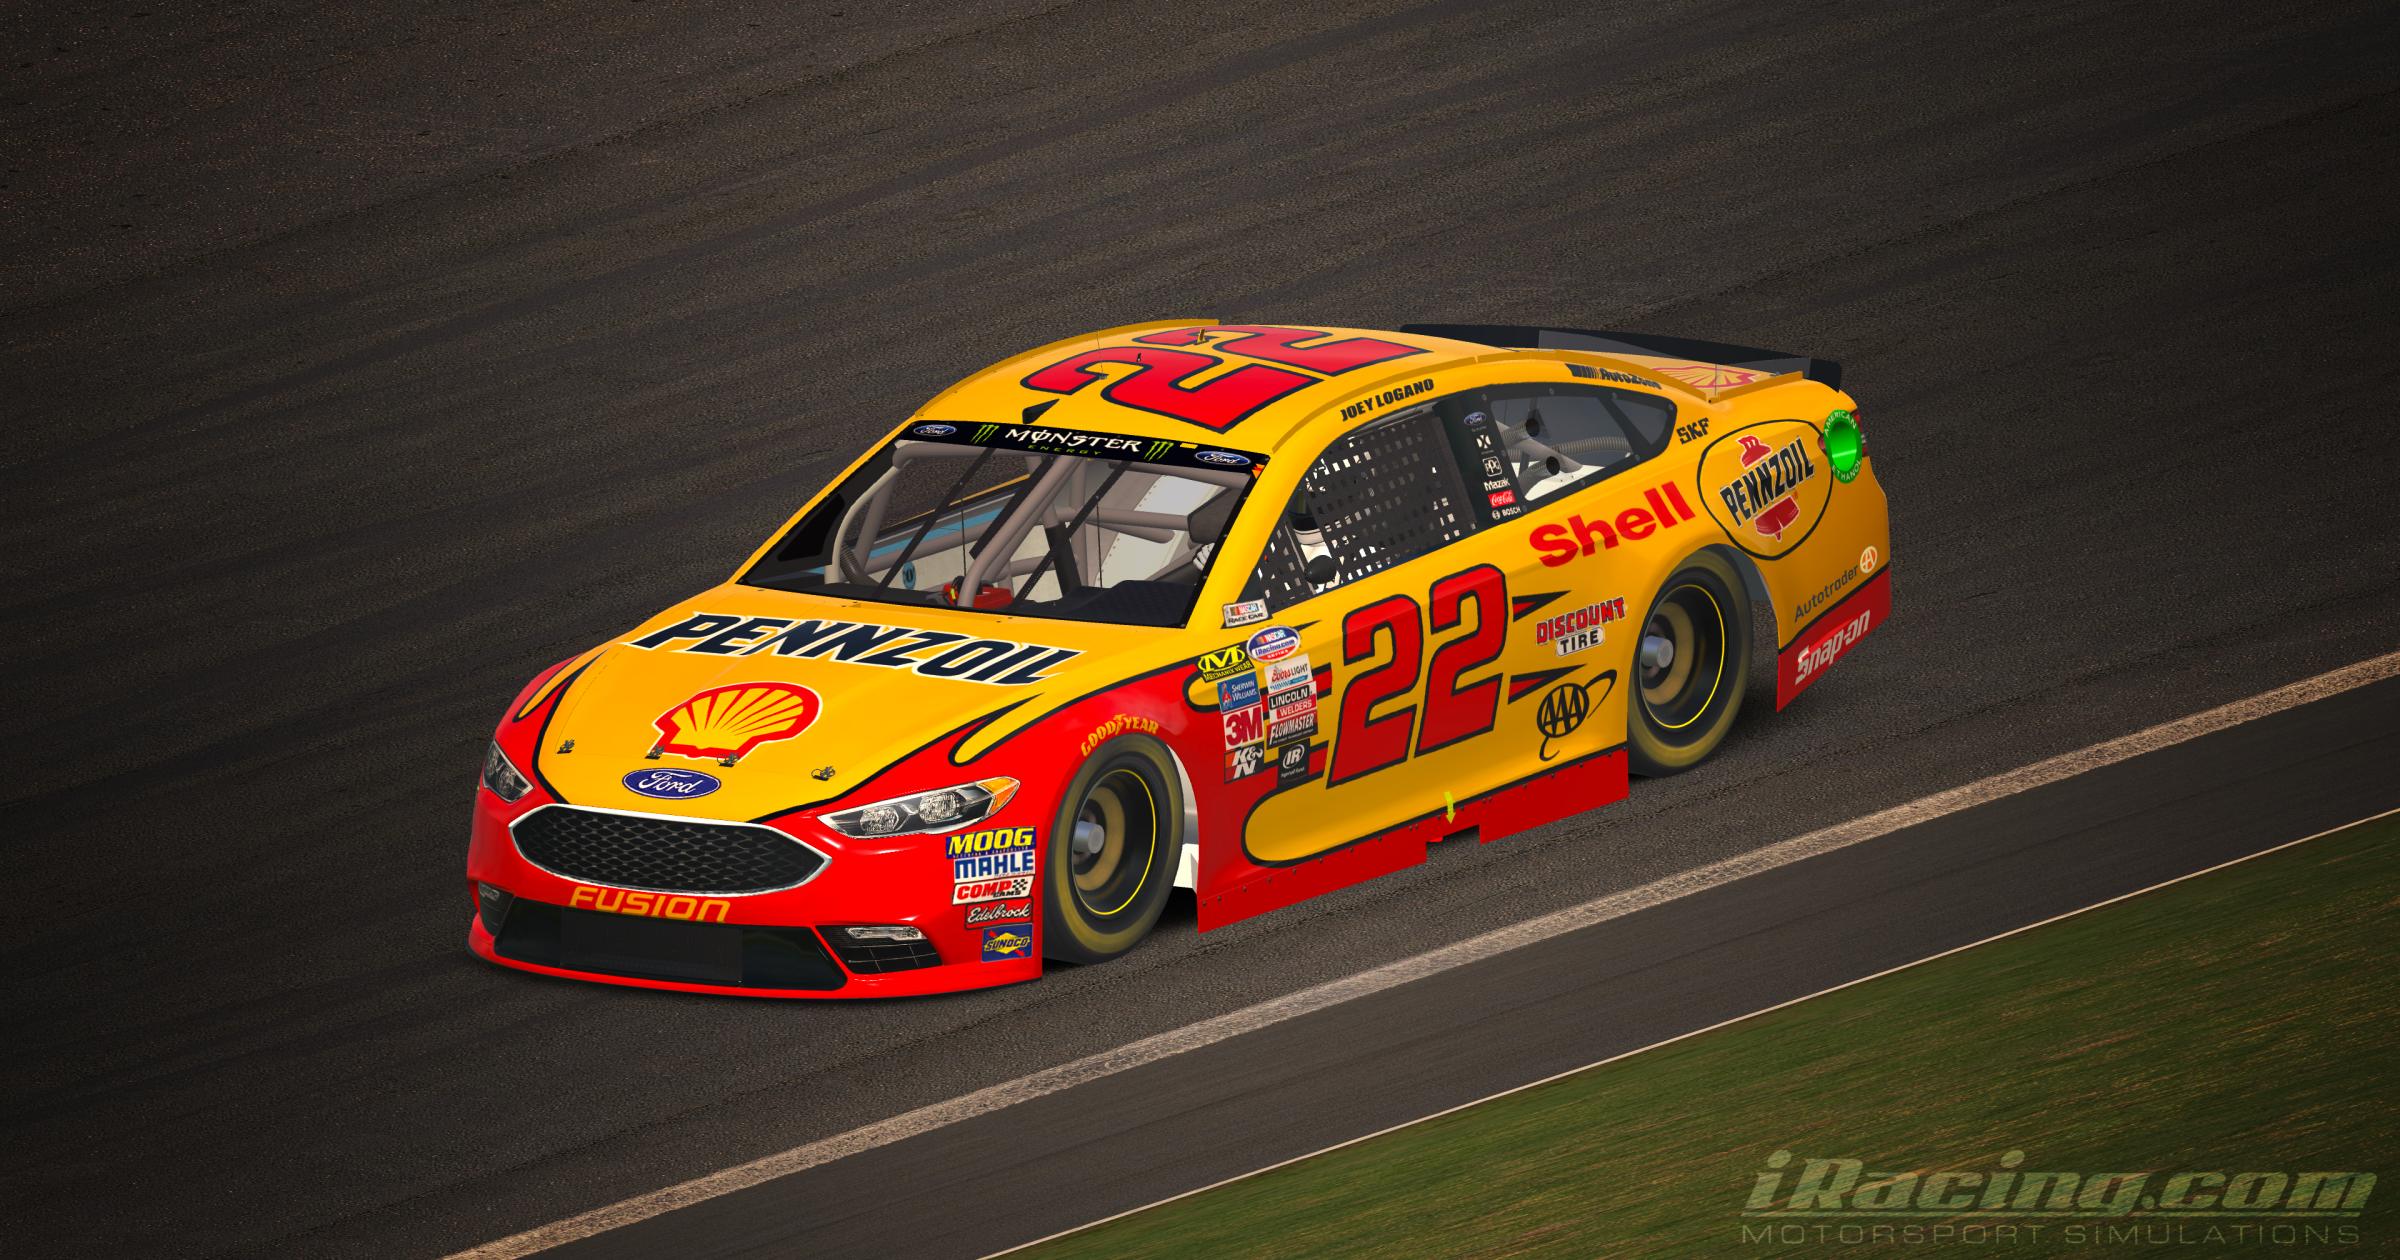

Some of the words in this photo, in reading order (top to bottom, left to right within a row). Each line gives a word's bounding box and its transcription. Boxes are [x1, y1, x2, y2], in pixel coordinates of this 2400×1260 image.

[1340, 397, 1374, 422] JOEY
[1375, 378, 1435, 408] LOGANO
[1676, 417, 1710, 445] SKF
[1824, 410, 1857, 438] AMERICAN
[1028, 444, 1102, 455] ENERGY
[1719, 435, 1815, 528] PENNZOIL
[1831, 459, 1862, 482] ETHANOL
[1484, 478, 1511, 492] Mazak
[1502, 506, 1521, 517] BOSCH
[1529, 481, 1696, 568] Shell
[1794, 564, 1859, 623] Autotrader
[1228, 614, 1247, 624] RACE
[1536, 597, 1625, 645] DISCOUNT
[620, 611, 1086, 685] PENNZOIL
[1560, 630, 1599, 654] TIRE
[1794, 609, 1871, 686] Snap-on
[1235, 660, 1253, 672] WEAR
[1271, 666, 1292, 683] Coors
[1291, 663, 1309, 678] LIGHT
[1326, 562, 1509, 790] 22
[1270, 687, 1308, 709] LINCOLN
[1279, 700, 1313, 718] WELDERS
[1540, 683, 1589, 738] AAA
[1225, 706, 1263, 746] 3M
[1269, 713, 1315, 746] FLOWMASTER
[638, 771, 704, 794] Ford
[948, 827, 1035, 856] MOOG
[954, 851, 1034, 879] MAHLE
[956, 880, 1013, 900] COMP
[569, 886, 731, 924] FUSION
[967, 902, 1032, 923] Edelbrock
[984, 936, 1031, 951] SUNOCO
